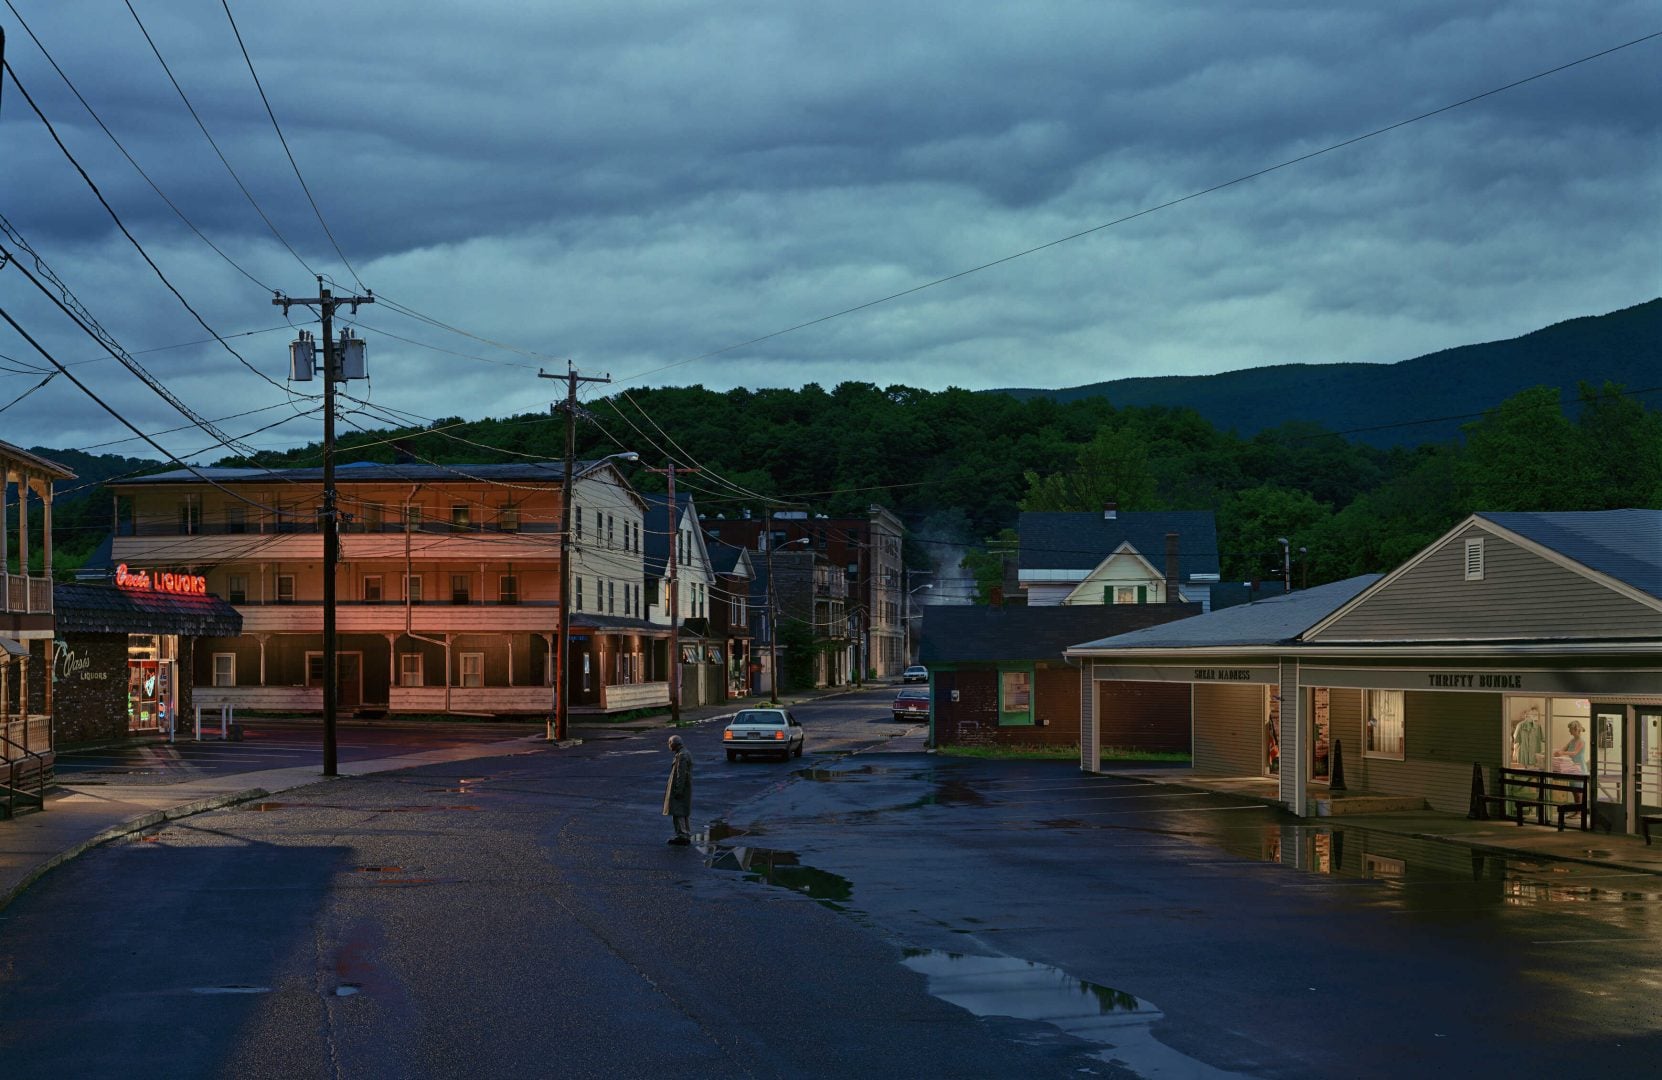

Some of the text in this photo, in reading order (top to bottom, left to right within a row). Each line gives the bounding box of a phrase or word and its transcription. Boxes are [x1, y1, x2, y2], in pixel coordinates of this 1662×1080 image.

[154, 571, 206, 593] LIQUORS
[63, 649, 90, 678] Oasis
[80, 671, 107, 681] LIQUORS
[1194, 669, 1250, 680] SHEAR MADNESS
[1428, 674, 1522, 689] THRIFTY BUNDLE
